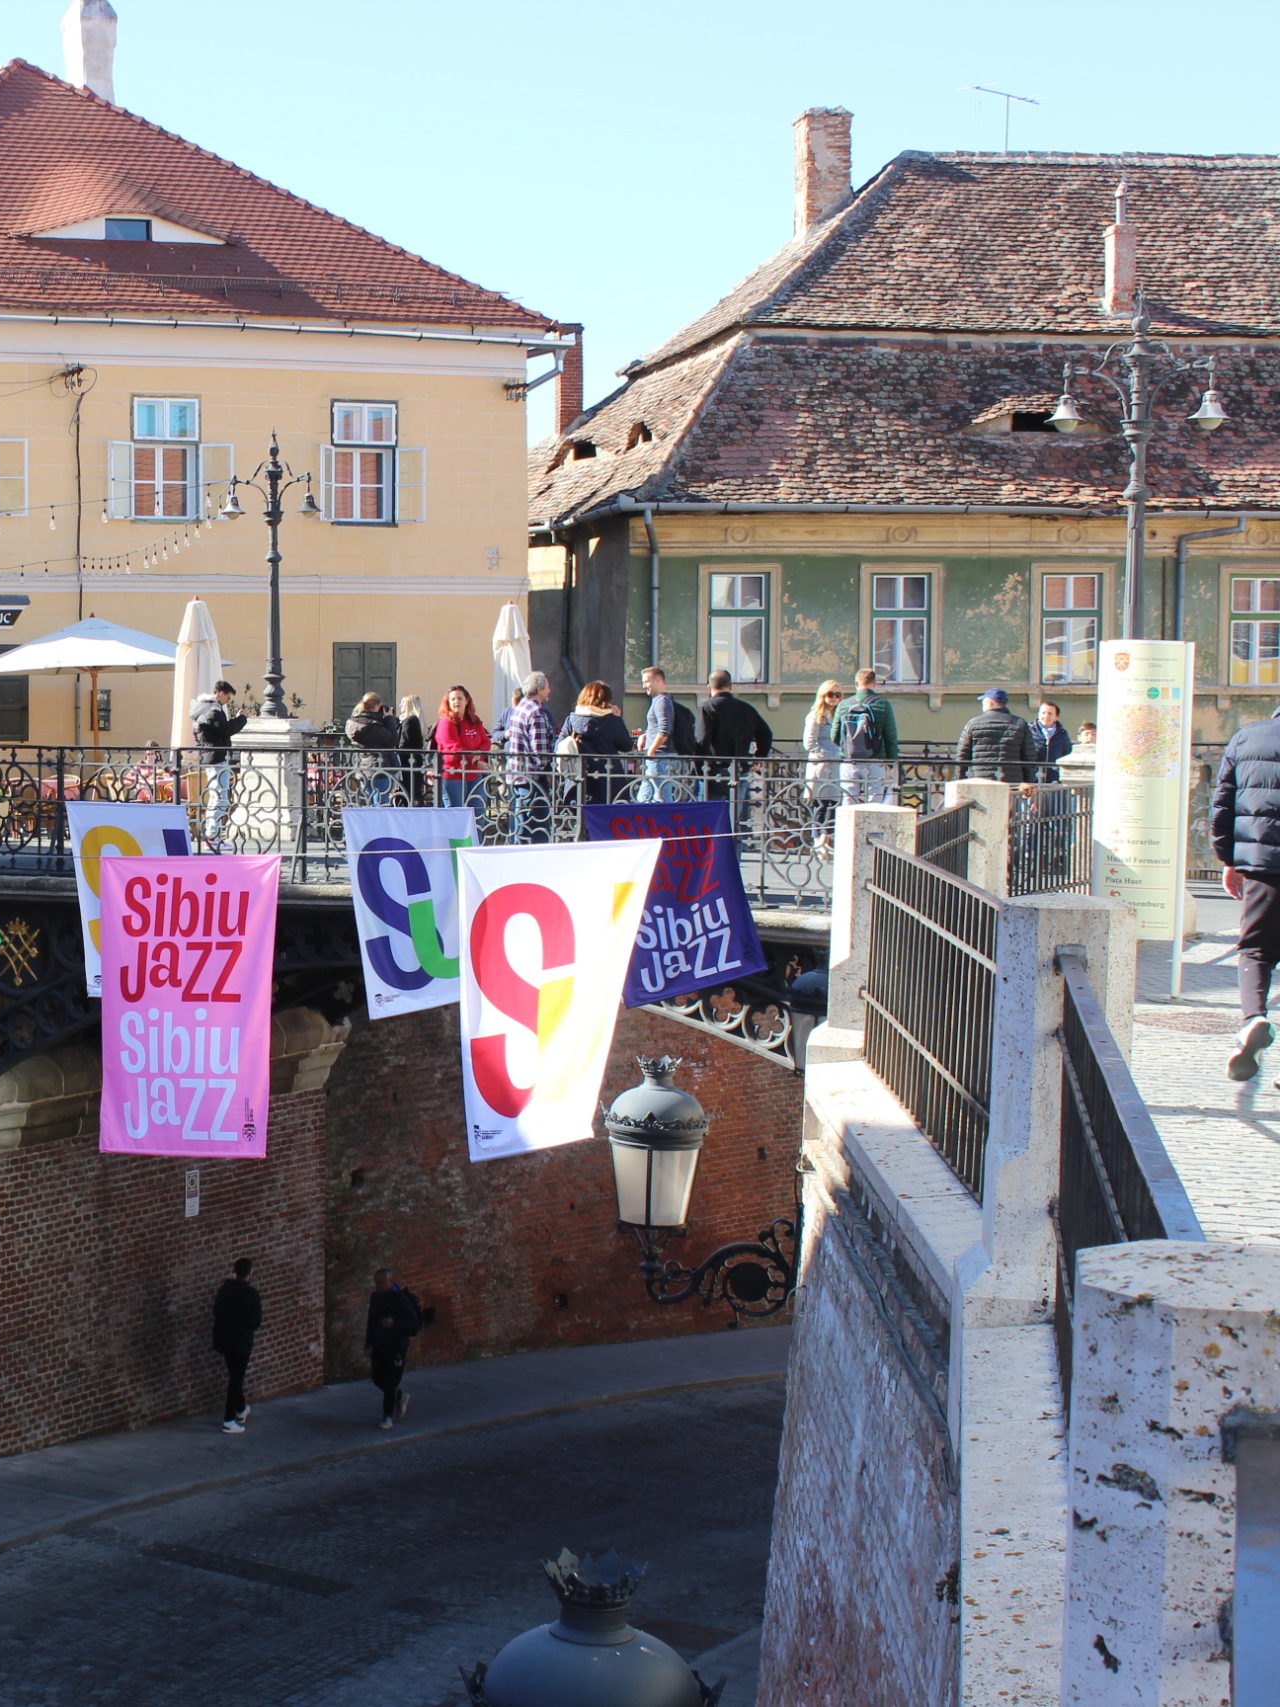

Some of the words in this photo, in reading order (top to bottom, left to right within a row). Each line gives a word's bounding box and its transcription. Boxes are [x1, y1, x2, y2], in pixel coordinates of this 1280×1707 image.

[122, 873, 250, 938] Sibiu
[636, 897, 730, 950] Sibiu
[119, 1008, 240, 1076] Sibiu
